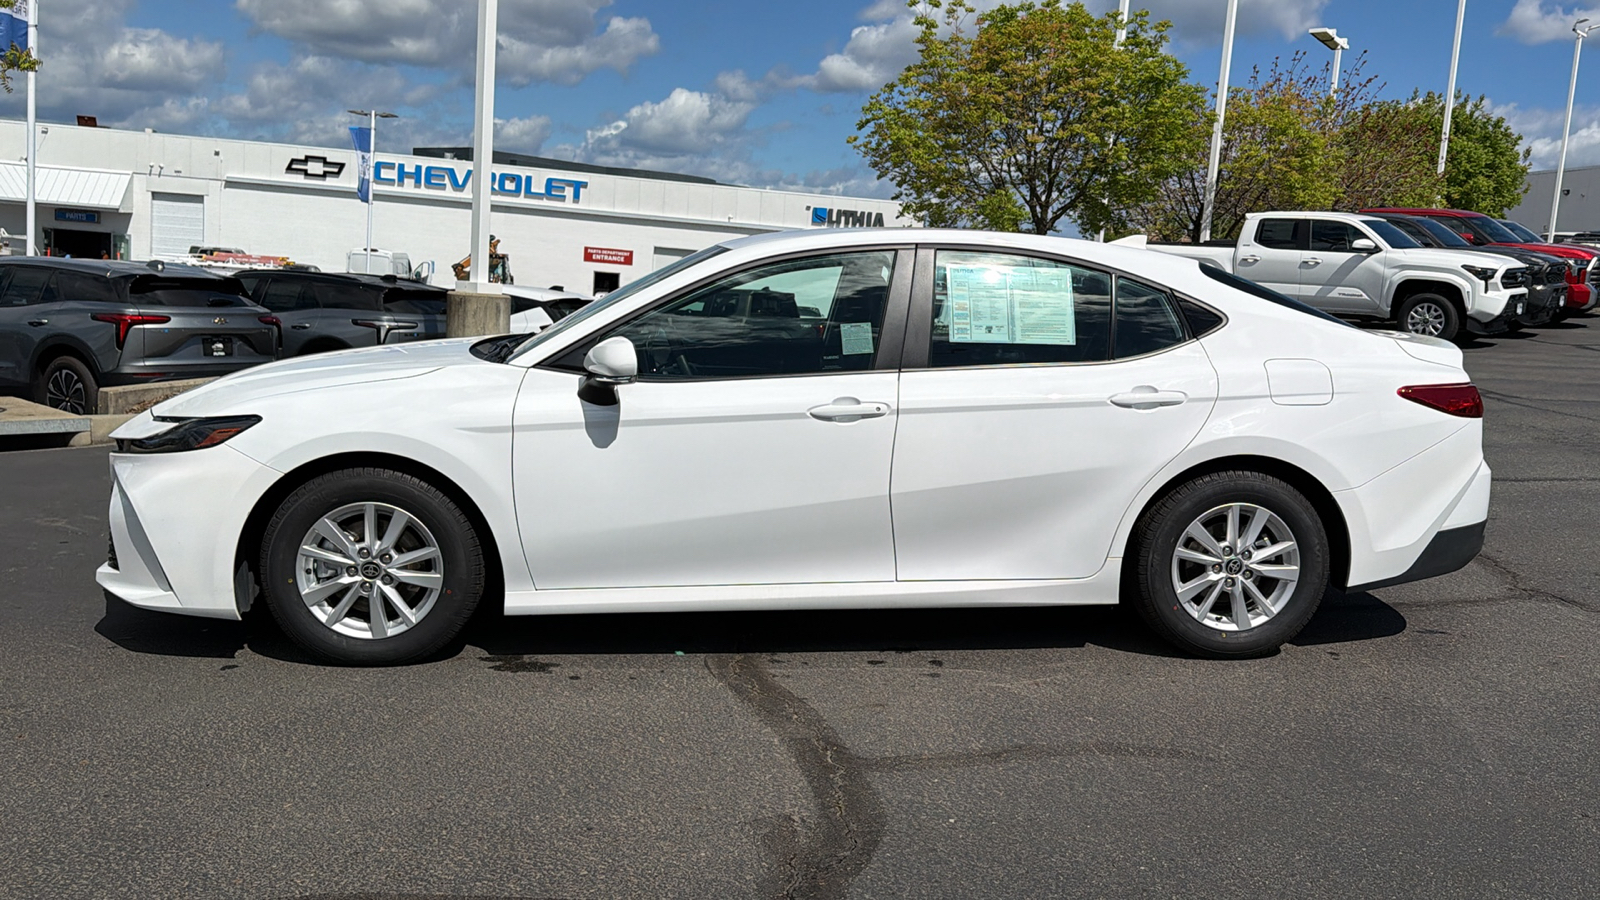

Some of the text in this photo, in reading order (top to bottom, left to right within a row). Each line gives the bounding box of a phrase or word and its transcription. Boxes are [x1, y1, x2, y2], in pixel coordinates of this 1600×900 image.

[374, 161, 588, 202] CHEVOLET
[827, 208, 885, 227] LITHIA
[592, 254, 625, 262] ENTRANCE
